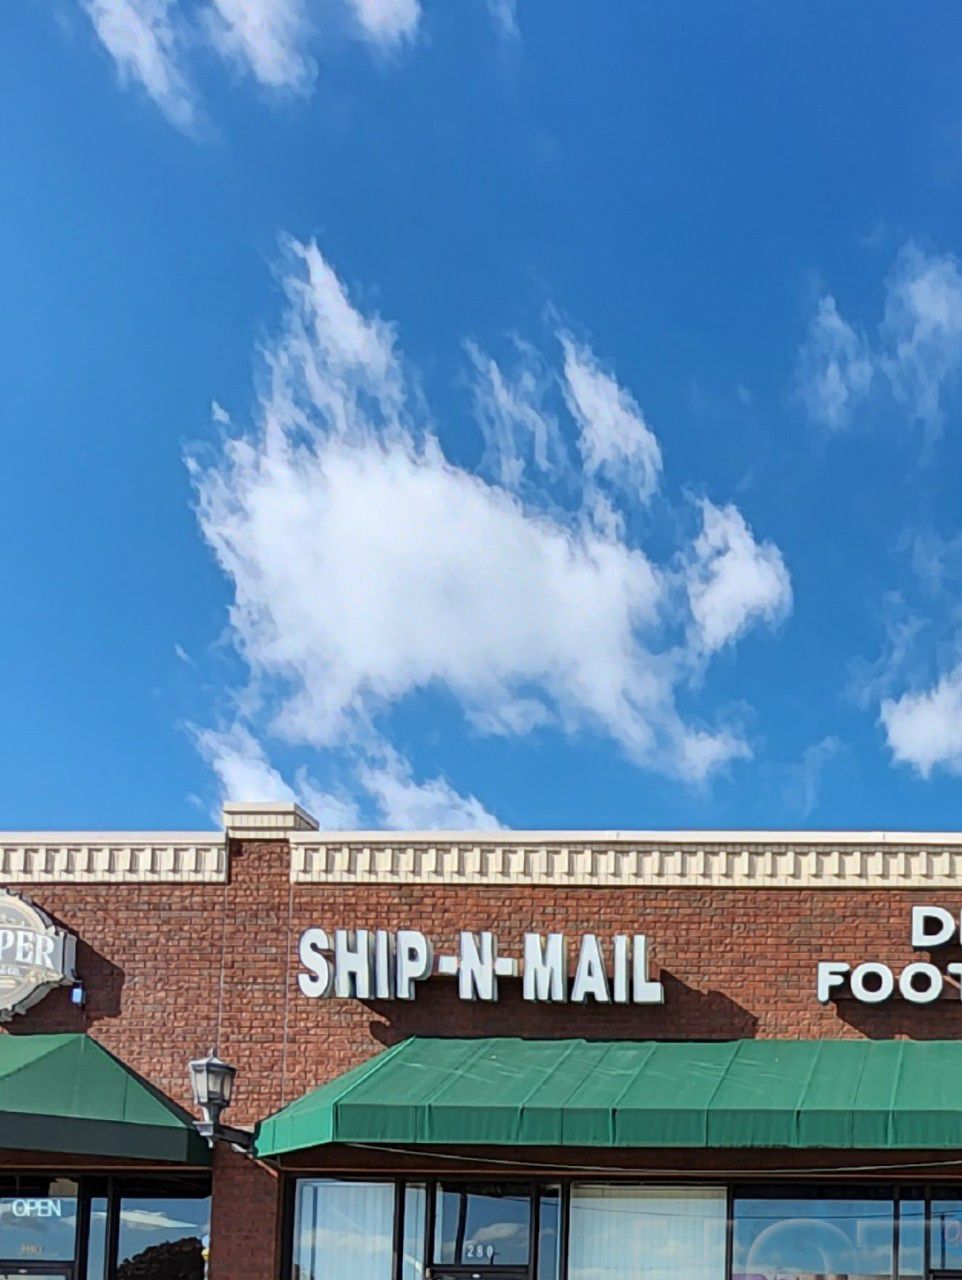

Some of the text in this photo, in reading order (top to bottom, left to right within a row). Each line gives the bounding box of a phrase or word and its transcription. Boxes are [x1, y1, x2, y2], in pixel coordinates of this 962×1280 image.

[299, 927, 665, 1004] SHIP-N-MAIL
[12, 1198, 61, 1217] OPEN
[466, 1244, 493, 1258] 280
